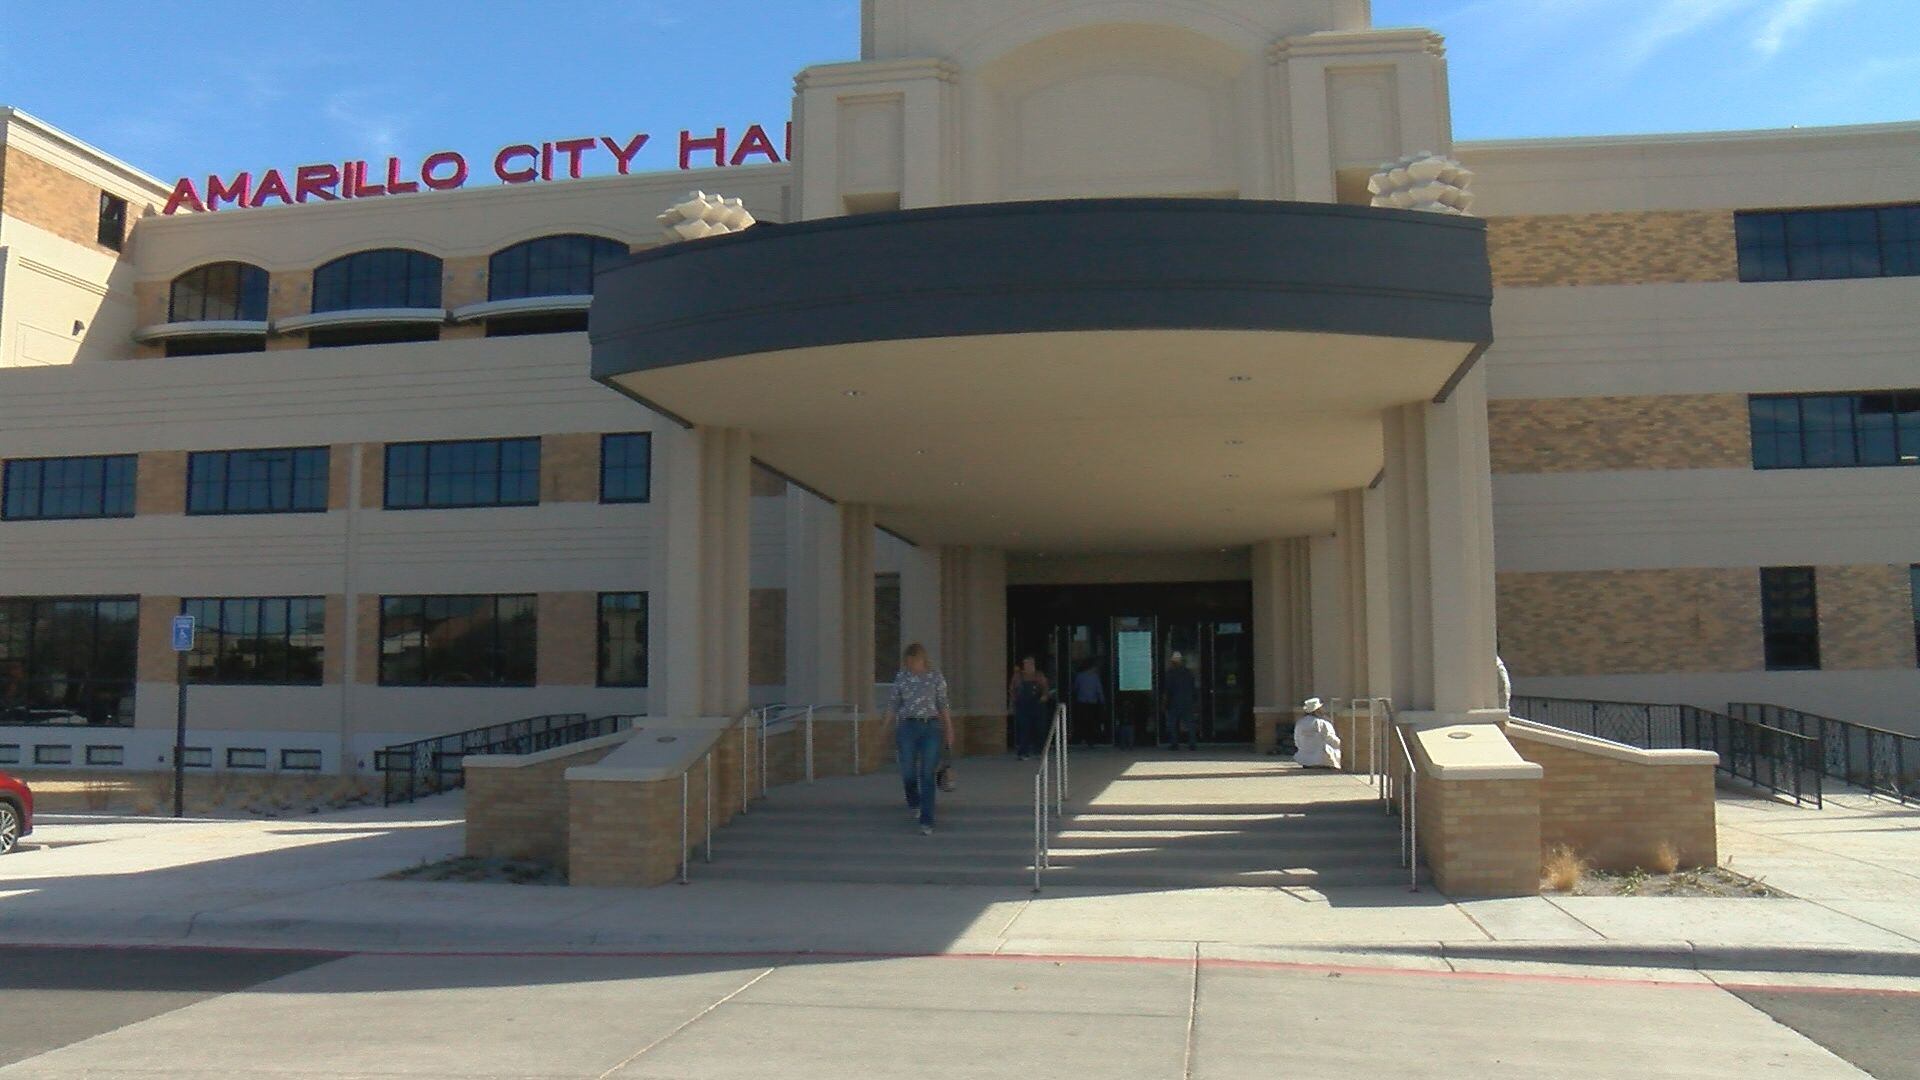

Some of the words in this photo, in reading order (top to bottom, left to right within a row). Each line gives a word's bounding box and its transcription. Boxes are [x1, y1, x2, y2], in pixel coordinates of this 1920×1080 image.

[162, 151, 468, 215] AMARILLO
[494, 133, 650, 184] CITY
[679, 121, 792, 169] HA
